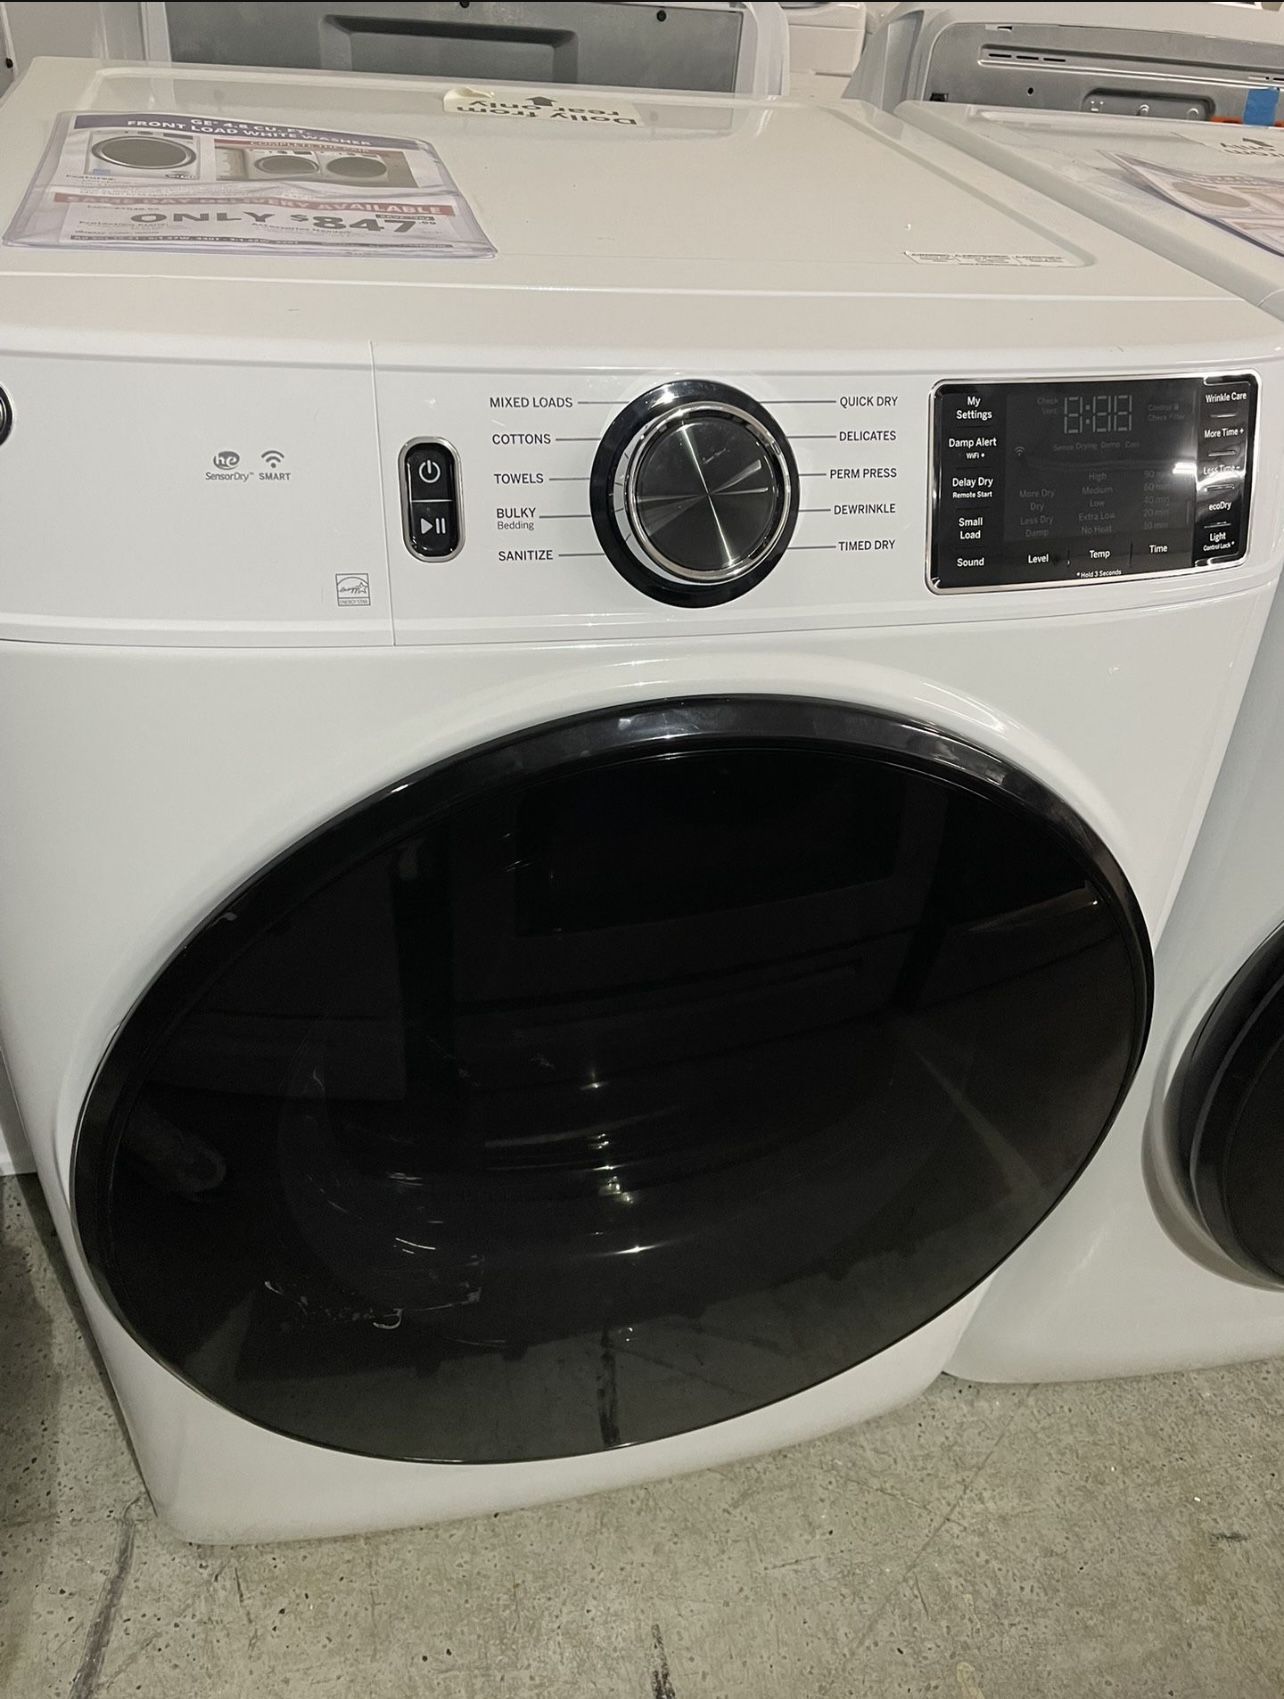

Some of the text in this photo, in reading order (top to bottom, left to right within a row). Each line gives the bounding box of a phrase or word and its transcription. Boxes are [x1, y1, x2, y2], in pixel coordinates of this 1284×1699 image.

[469, 100, 619, 116] rear only
[457, 106, 637, 125] Dolly from
[127, 120, 372, 145] FRONT LOAD WHITE WASHER
[318, 202, 442, 214] AVAILABLE
[130, 211, 275, 223] ONLY
[489, 397, 573, 408] MIXED LOADS
[839, 396, 898, 408] QUICK DRY
[967, 396, 981, 408] My
[1205, 391, 1247, 403] Wrinkle Care
[956, 409, 993, 421] Settings
[839, 430, 897, 441] DELICATES
[1204, 429, 1221, 438] More
[1222, 428, 1238, 437] Time
[492, 433, 551, 445] COTTONS
[948, 437, 997, 449] Damp Alert
[830, 467, 897, 479] PERM PRESS
[1203, 466, 1218, 475] Less
[259, 472, 291, 481] SMART
[494, 473, 544, 484] TOWELS
[952, 477, 994, 488] Delay Dry
[952, 490, 993, 499] Remote Start
[834, 503, 896, 515] DEWRINKLE
[1030, 502, 1045, 512] Dry
[1208, 501, 1232, 511] ecoDry
[496, 507, 536, 518] BULKY
[497, 521, 534, 531] Bedding
[958, 517, 983, 527] Small
[960, 530, 981, 540] Load
[1209, 532, 1226, 543] Light
[838, 539, 896, 551] TIMED DRY
[1149, 544, 1168, 553] Time
[1203, 543, 1219, 551] Control
[498, 549, 553, 561] SANITIZE
[1028, 554, 1049, 564] Level
[1089, 550, 1111, 560] Temp
[957, 557, 985, 567] Sound
[1099, 569, 1122, 577] Seconds
